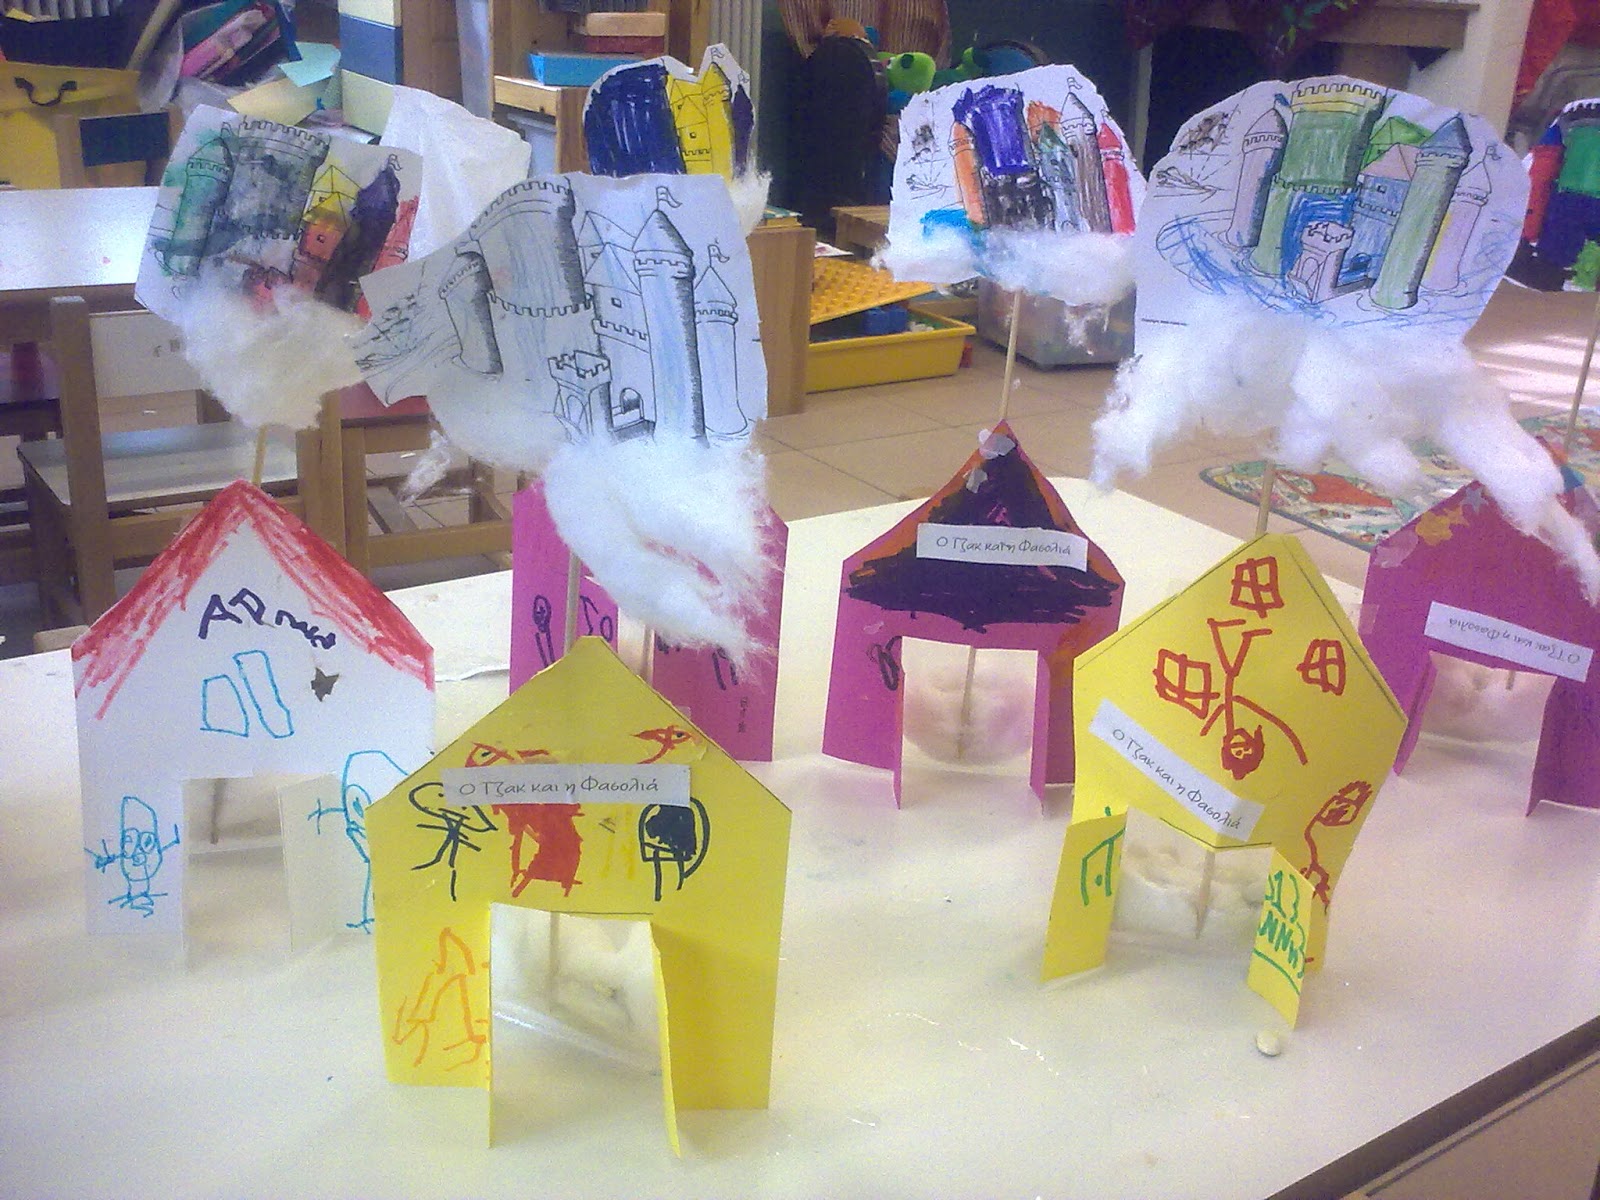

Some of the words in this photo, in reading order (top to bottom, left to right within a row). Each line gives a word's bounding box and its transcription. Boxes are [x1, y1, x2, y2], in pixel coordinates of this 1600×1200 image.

[936, 536, 948, 547] Ο
[952, 537, 981, 553] Τζακ
[459, 783, 475, 796] Ο
[482, 781, 526, 797] Τζακ
[531, 782, 558, 793] και
[566, 782, 576, 795] η
[581, 775, 659, 793] Φασολιά
[1112, 729, 1125, 741] Ο
[1126, 738, 1155, 769] Τζακ
[1155, 765, 1174, 785] και
[1176, 783, 1186, 795] η
[1187, 789, 1241, 830] Φασολιά
